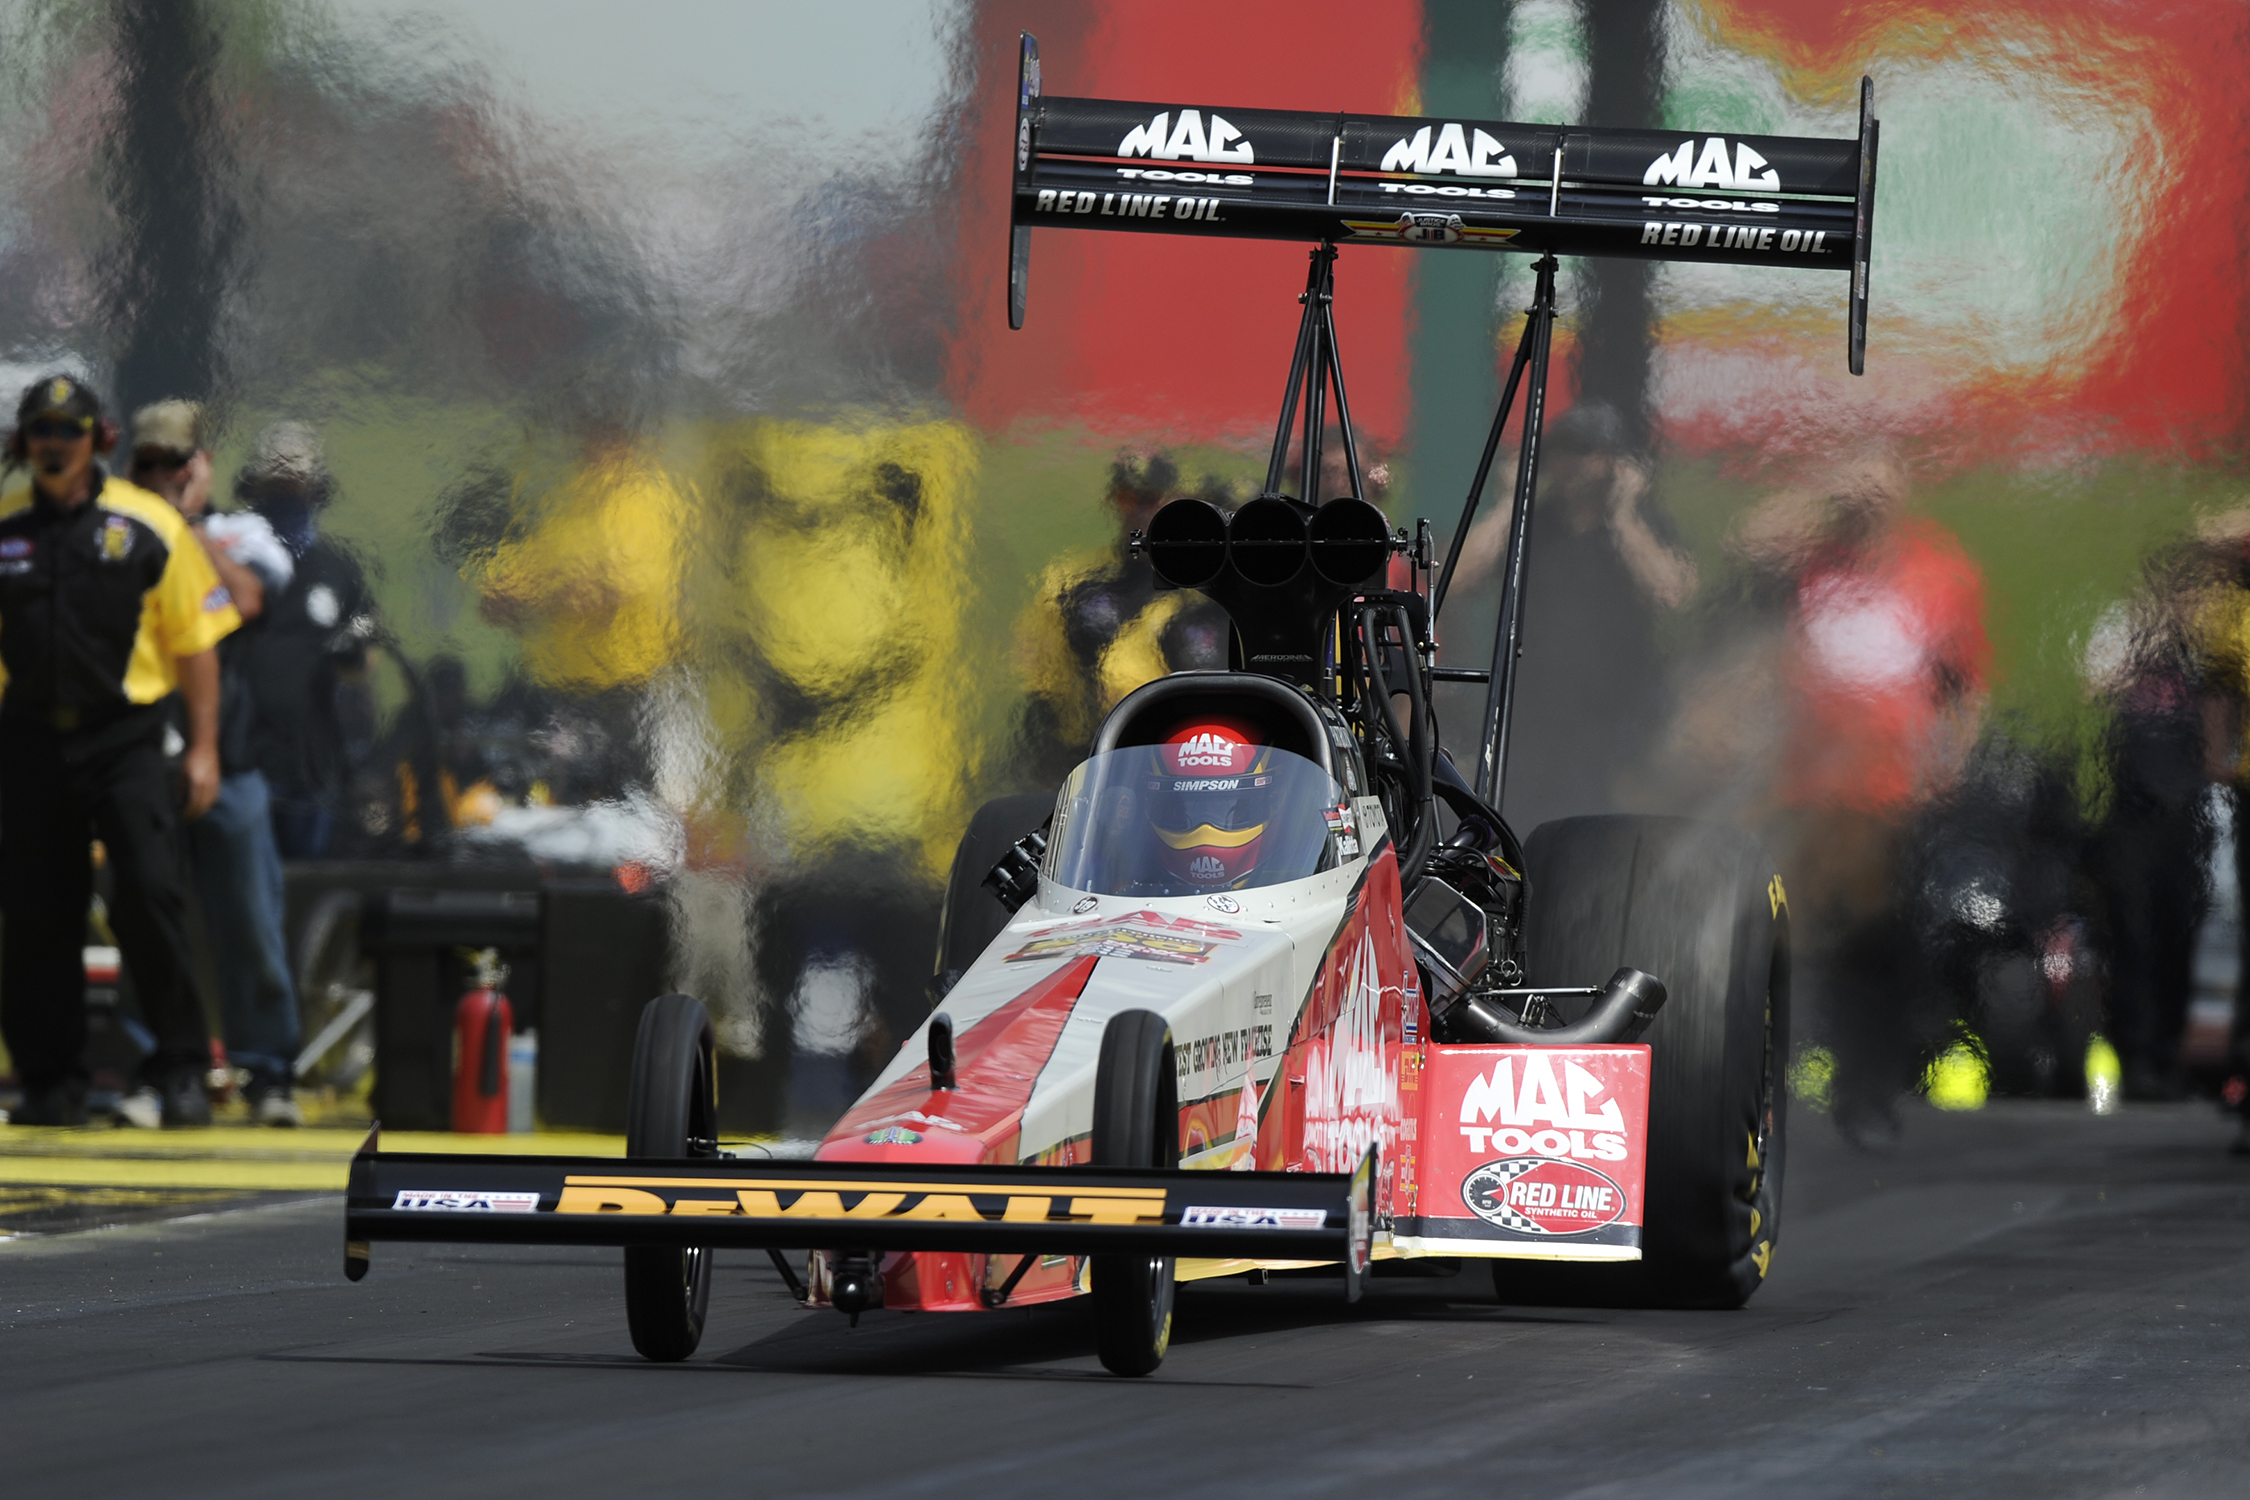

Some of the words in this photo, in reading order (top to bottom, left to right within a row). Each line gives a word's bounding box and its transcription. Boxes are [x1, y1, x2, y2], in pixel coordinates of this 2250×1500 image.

[1116, 109, 1254, 164] MAC
[1379, 123, 1518, 178] MAC
[1643, 137, 1781, 191] MAC
[1116, 168, 1254, 185] TOOLS
[1035, 189, 1096, 214] RED
[1100, 193, 1171, 219] LINE
[1378, 183, 1516, 198] TOOLS
[1642, 197, 1780, 213] TOOLS
[1640, 222, 1702, 246] RED
[1706, 226, 1776, 252] LINE
[1178, 733, 1233, 757] MAC
[1178, 756, 1232, 767] TOOLS
[1173, 779, 1240, 791] SIMPSON
[1190, 856, 1225, 873] MAC
[1190, 872, 1225, 880] TOOLS
[1222, 1030, 1239, 1065] NEW
[1460, 1053, 1626, 1133] MAC
[1460, 1126, 1628, 1161] TOOLS
[1510, 1181, 1557, 1207] RED
[1560, 1184, 1613, 1212] LINE
[1524, 1206, 1579, 1218] SYNTHETIC
[1580, 1210, 1598, 1219] OIL
